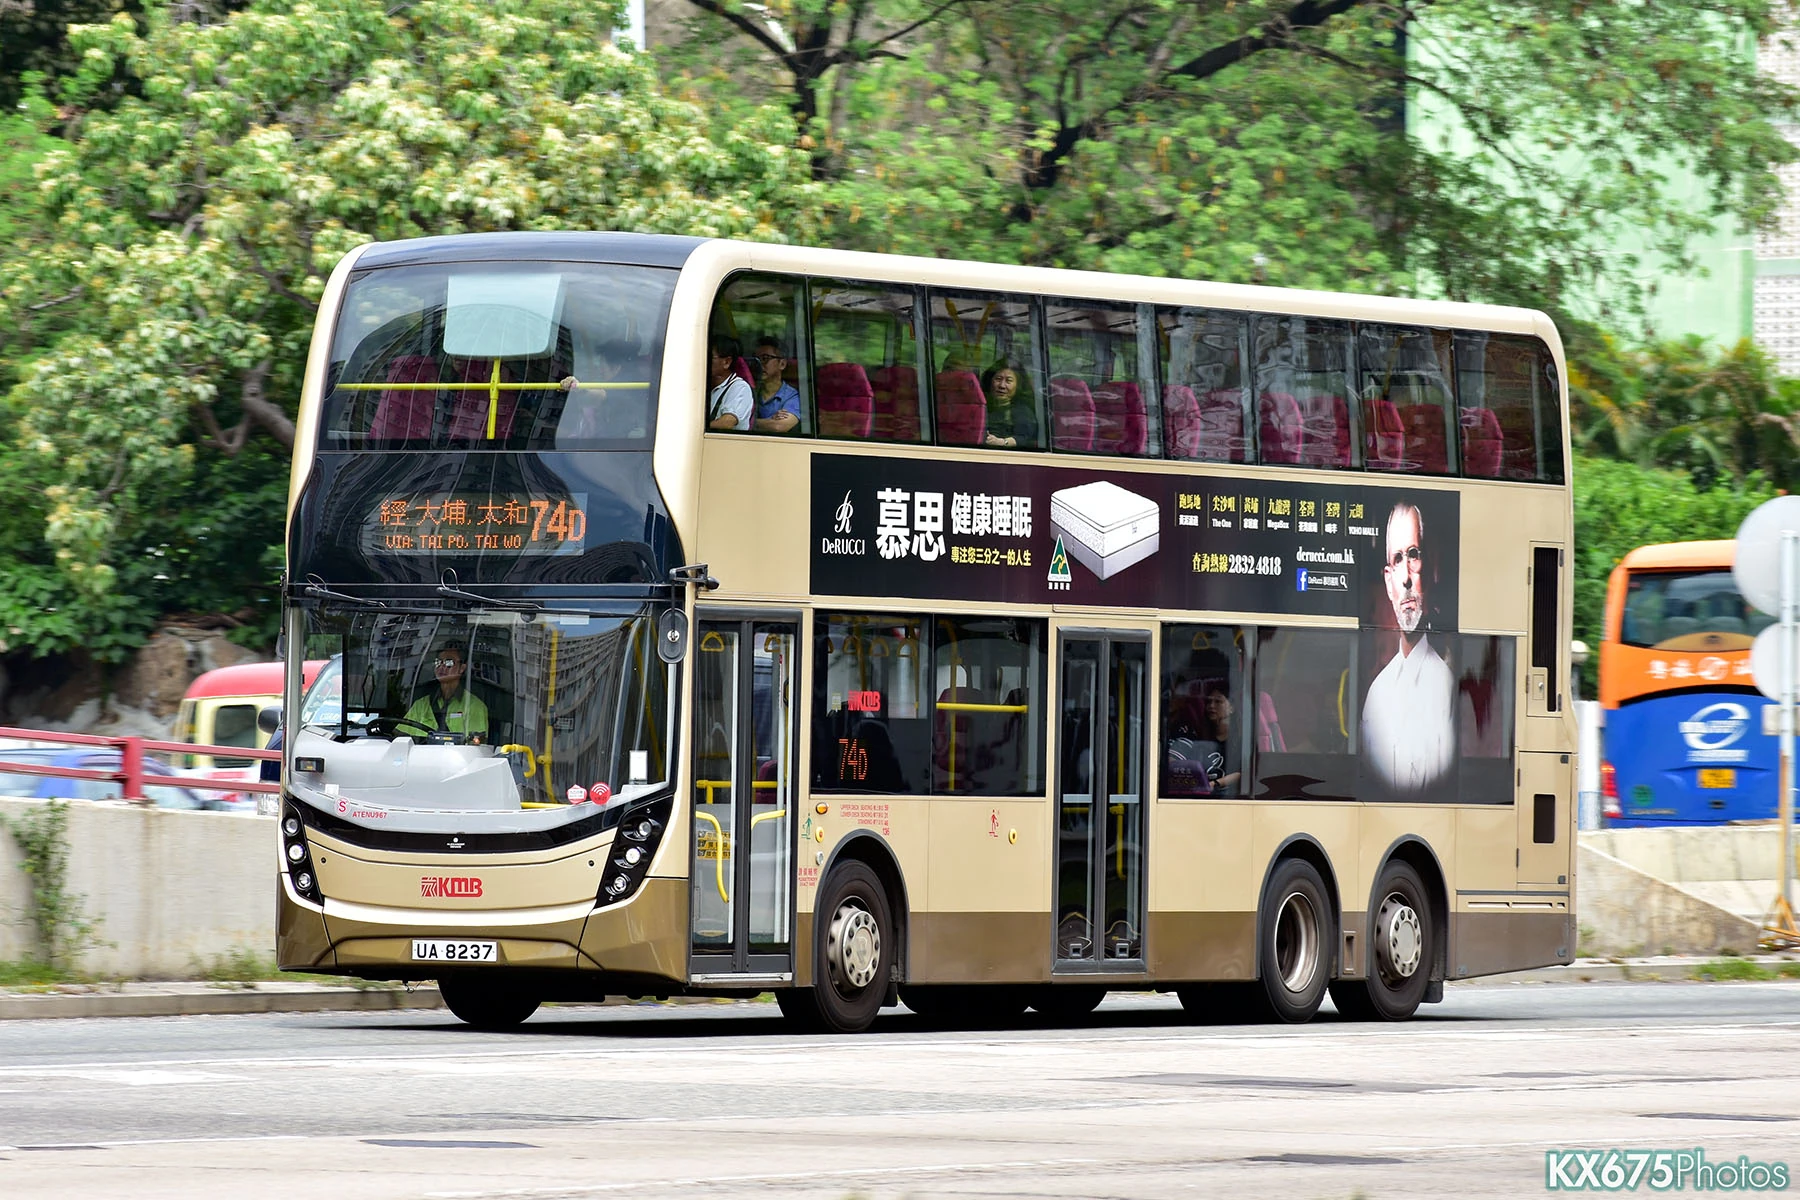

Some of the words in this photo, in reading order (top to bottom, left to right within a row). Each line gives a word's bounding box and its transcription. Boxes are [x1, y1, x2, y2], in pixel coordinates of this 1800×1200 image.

[1179, 493, 1201, 510] 跑馬地
[1212, 495, 1236, 512] 尖沙咀
[1243, 497, 1259, 514] 黃埔
[1267, 498, 1291, 516] 九龍灣
[1299, 500, 1315, 517] 荃灣
[1325, 501, 1341, 518] 荃灣
[951, 492, 1032, 538] 健康睡眠
[1348, 503, 1364, 519] 元朗
[530, 500, 586, 542] 74D
[876, 487, 946, 562] 慕思
[1212, 518, 1221, 528] The
[1221, 519, 1232, 528] One
[386, 535, 413, 548] VIA:
[420, 535, 443, 548] TAI
[448, 535, 469, 549] PO,
[474, 535, 499, 548] TAI
[503, 535, 522, 548] WO
[822, 537, 866, 556] DeRUCCI
[951, 546, 1032, 567] 專注您三分之一的人生
[1296, 546, 1355, 564] derucci.com.hk
[1192, 552, 1228, 572] 查詢熱線
[1228, 554, 1256, 574] 2832
[1256, 556, 1281, 576] 4818
[857, 691, 881, 711] KMB
[839, 738, 868, 780] 74D
[338, 801, 347, 812] S
[352, 810, 388, 819] ATENU967
[438, 877, 483, 897] KMB
[416, 943, 438, 959] UA
[445, 943, 493, 960] 8237
